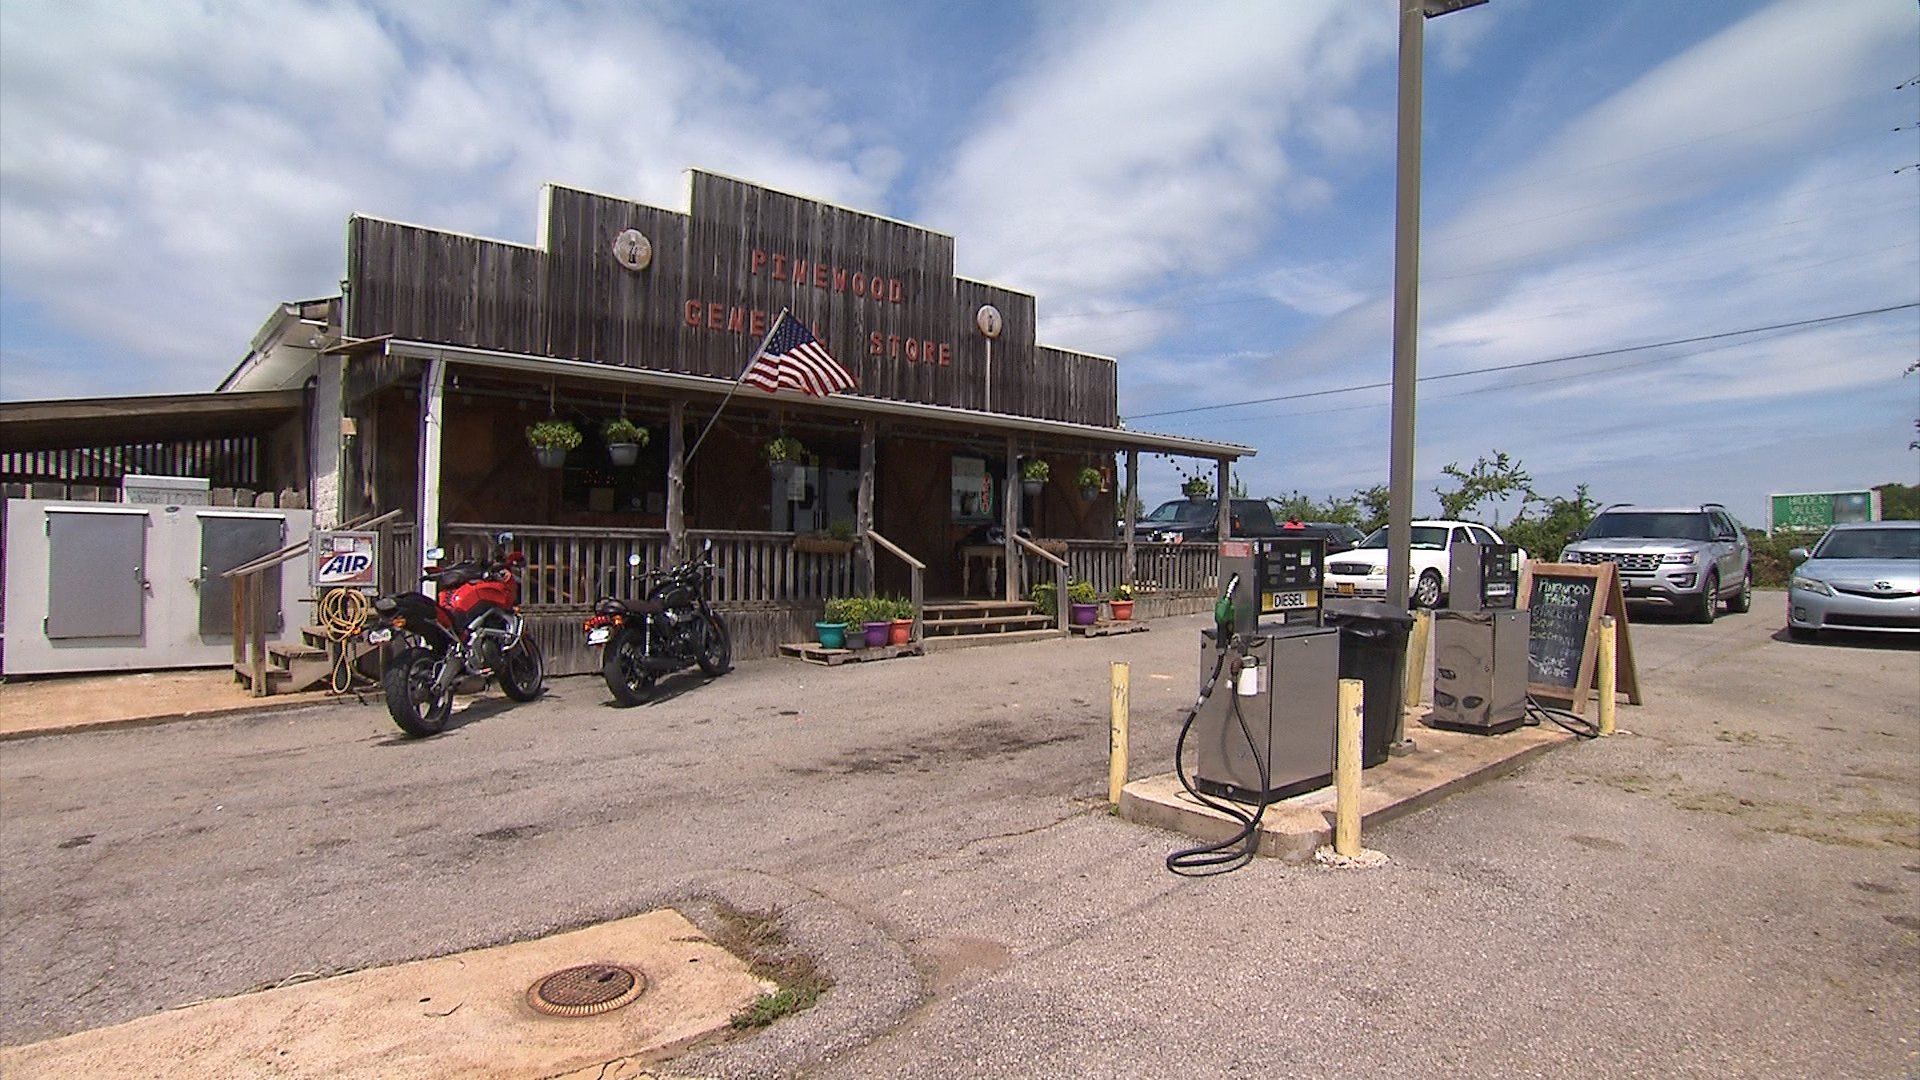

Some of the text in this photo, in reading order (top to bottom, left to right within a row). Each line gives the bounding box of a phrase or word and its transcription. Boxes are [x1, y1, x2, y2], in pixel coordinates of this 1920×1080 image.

[751, 249, 904, 304] PINEWOOD
[685, 299, 951, 367] GENEL STORE
[1788, 495, 1828, 506] HIDDEN
[322, 555, 368, 575] AIR
[1274, 592, 1305, 607] DIESEL
